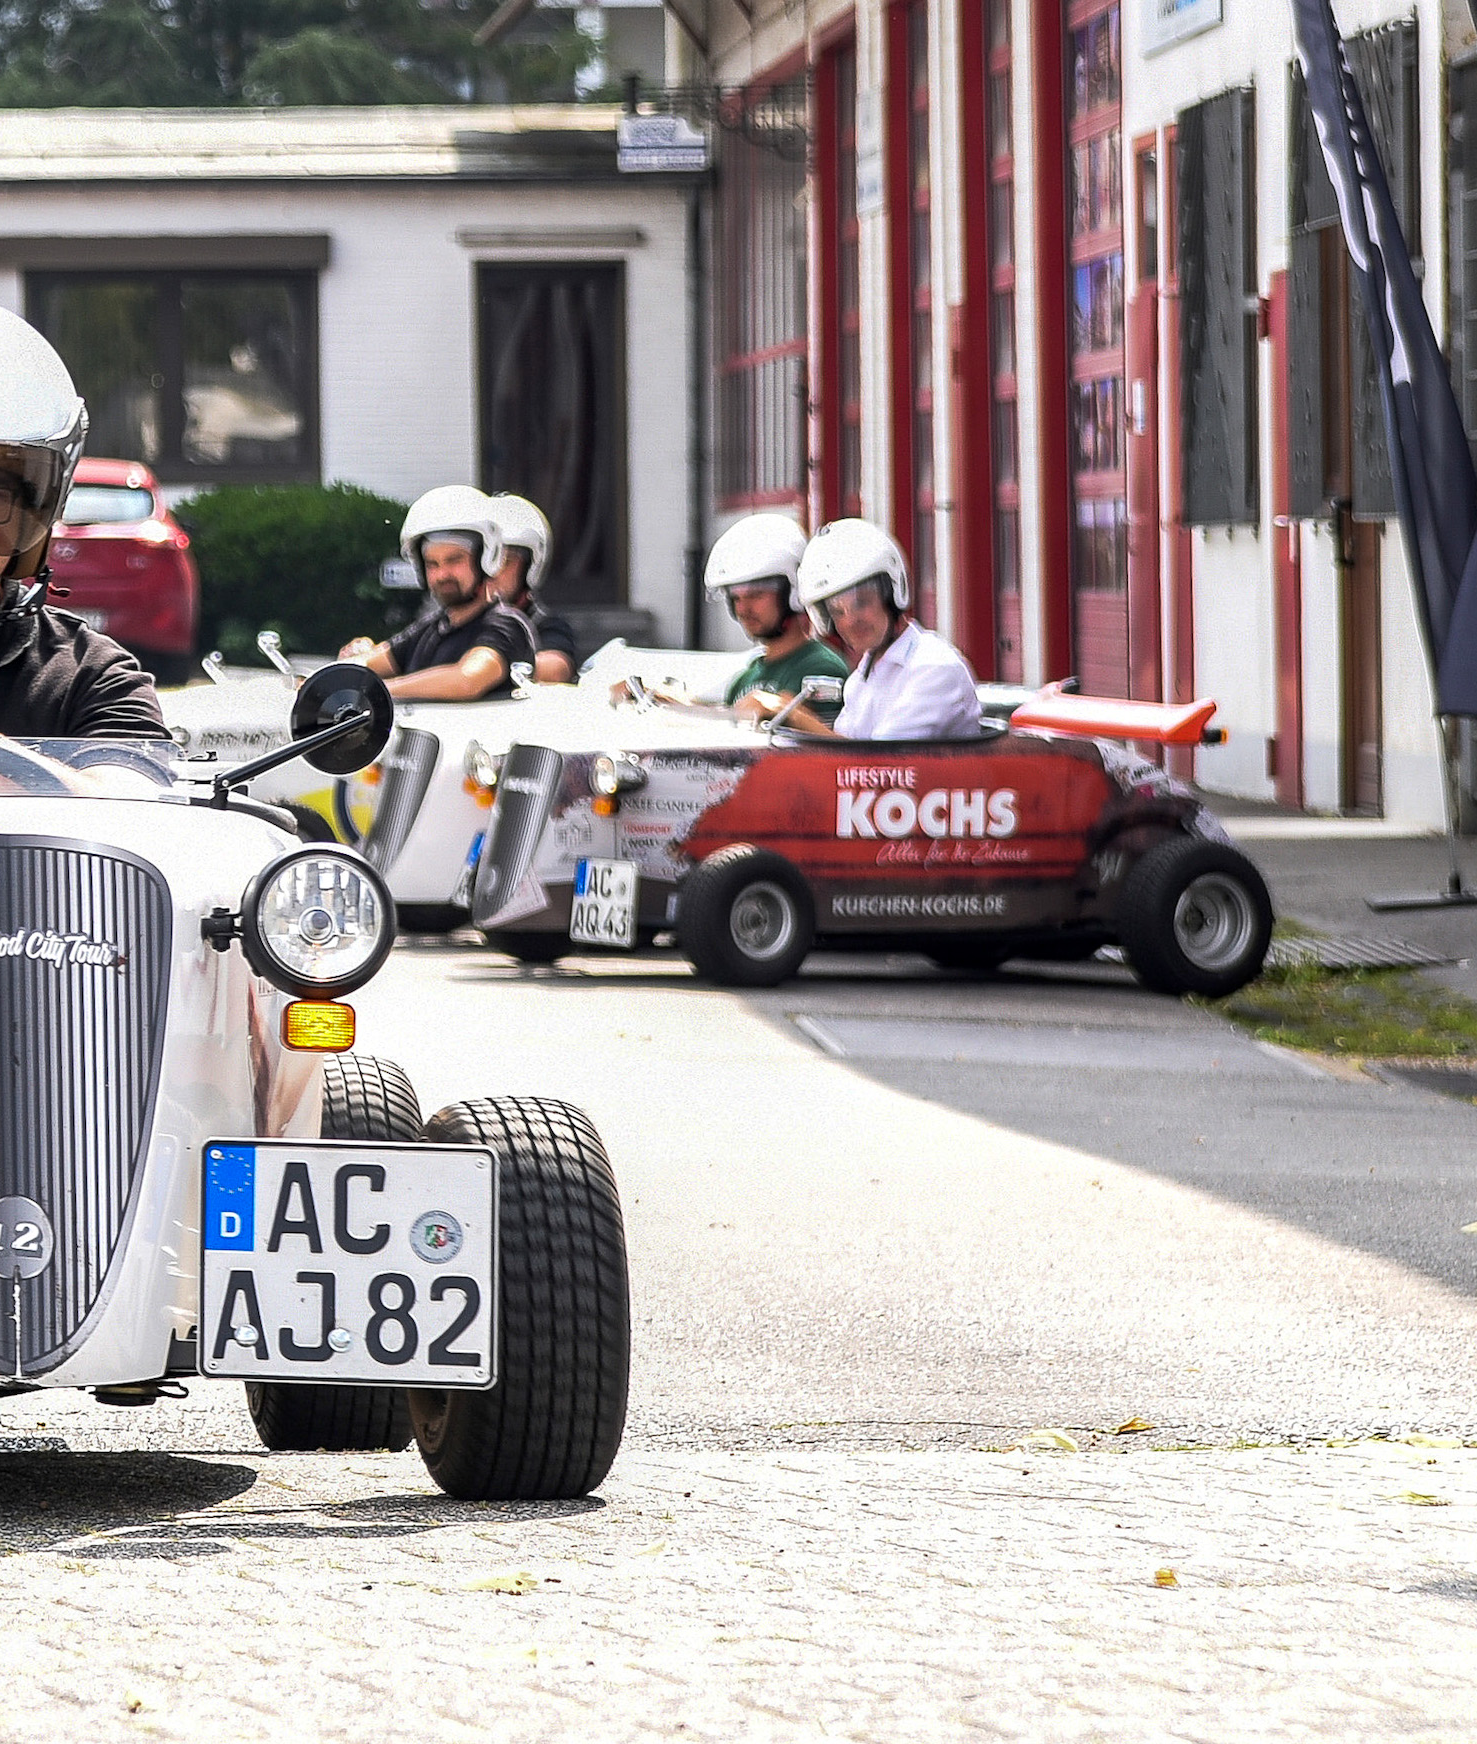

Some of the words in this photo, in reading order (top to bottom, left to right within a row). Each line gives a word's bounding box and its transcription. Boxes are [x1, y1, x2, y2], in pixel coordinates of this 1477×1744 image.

[837, 767, 916, 789] LIFESTYLE
[836, 789, 1016, 838] KOCHS
[587, 866, 612, 898] AC
[832, 894, 1006, 917] KUECHEN-KOCHS.DE
[25, 930, 66, 968] City
[65, 935, 112, 965] Tour
[267, 1162, 391, 1254] AC
[220, 1212, 241, 1238] D
